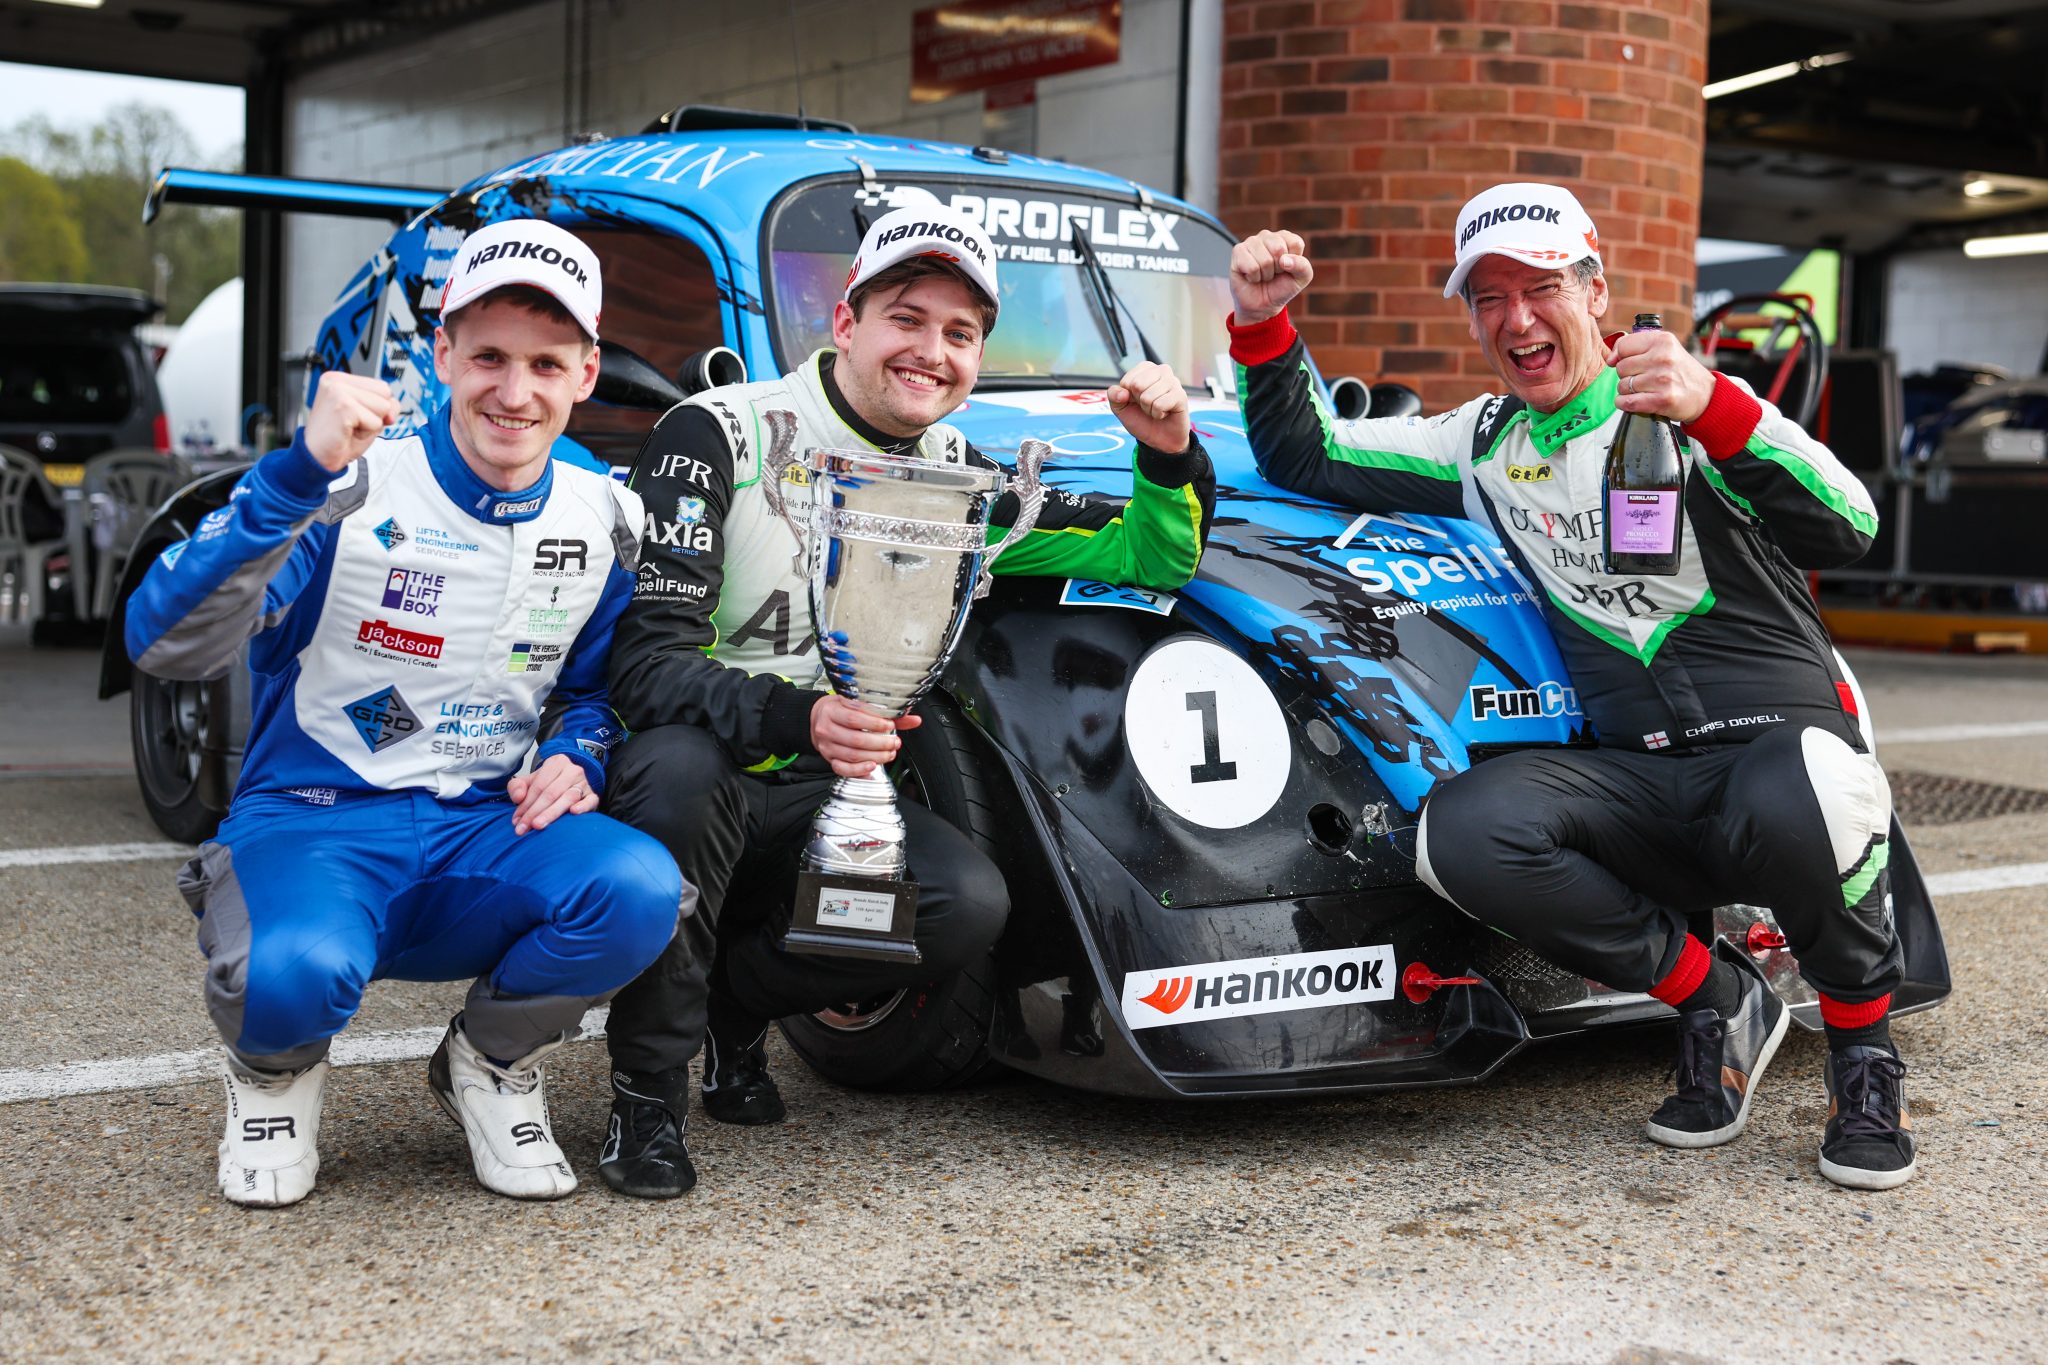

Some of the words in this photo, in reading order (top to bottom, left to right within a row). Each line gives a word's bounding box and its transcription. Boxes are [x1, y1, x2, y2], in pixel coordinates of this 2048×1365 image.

[951, 194, 1180, 251] PROFLEX
[1010, 245, 1056, 263] FUEL
[1136, 254, 1190, 273] TANKS
[651, 454, 713, 490] JPR
[415, 537, 479, 552] ENGINEERING
[416, 526, 440, 538] LIFTS
[645, 512, 713, 553] Axia
[1365, 535, 1427, 553] The
[416, 547, 461, 560] SERVICES
[533, 538, 588, 571] SR
[671, 547, 699, 557] METRICS
[411, 570, 446, 588] THE
[1346, 543, 1502, 596] Spell
[406, 584, 442, 602] LIFT
[1372, 600, 1429, 620] Equity
[1431, 593, 1486, 612] capital
[1484, 592, 1508, 606] for
[403, 600, 439, 617] BOX
[492, 703, 503, 716] &
[1470, 681, 1583, 722] FunCu
[352, 705, 415, 732] GRD
[1686, 720, 1725, 738] CHRIS
[1728, 713, 1786, 729] DOVELL
[1185, 690, 1238, 784] 1
[243, 1115, 296, 1141] SR
[511, 1121, 549, 1147] SR
